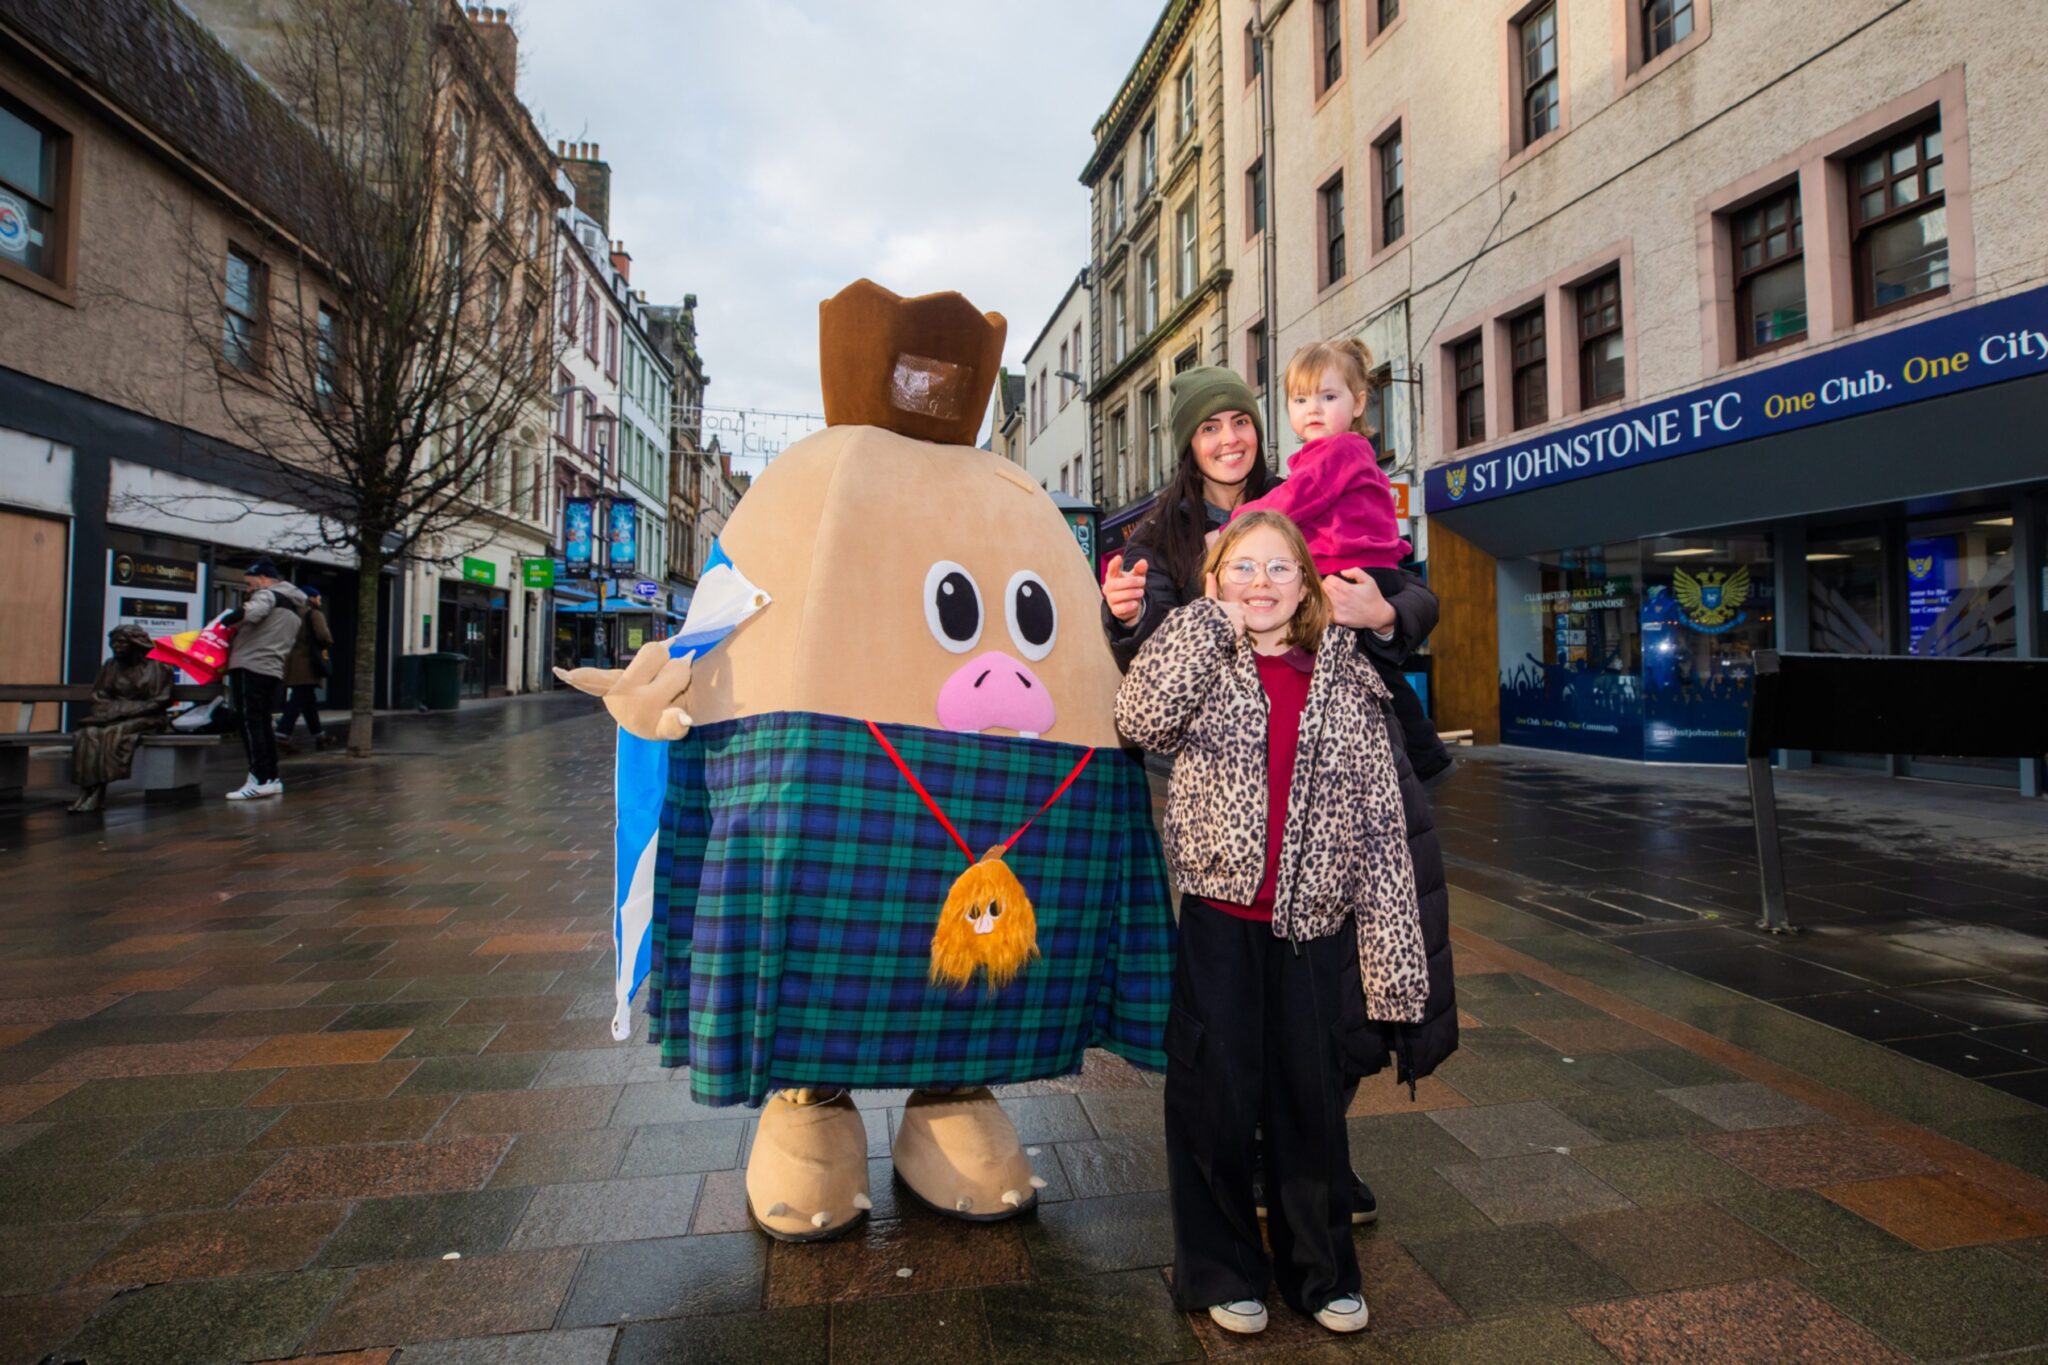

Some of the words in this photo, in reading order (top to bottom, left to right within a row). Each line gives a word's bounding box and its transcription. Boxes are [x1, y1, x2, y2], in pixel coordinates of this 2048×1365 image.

[1764, 391, 1816, 419] One
[1820, 369, 1893, 405] Club.
[1903, 352, 1970, 384] One
[1472, 458, 1501, 492] ST
[1505, 408, 1681, 489] JOHNSTONE
[1690, 391, 1743, 438] FC
[1571, 598, 1625, 610] MERCHANDISE
